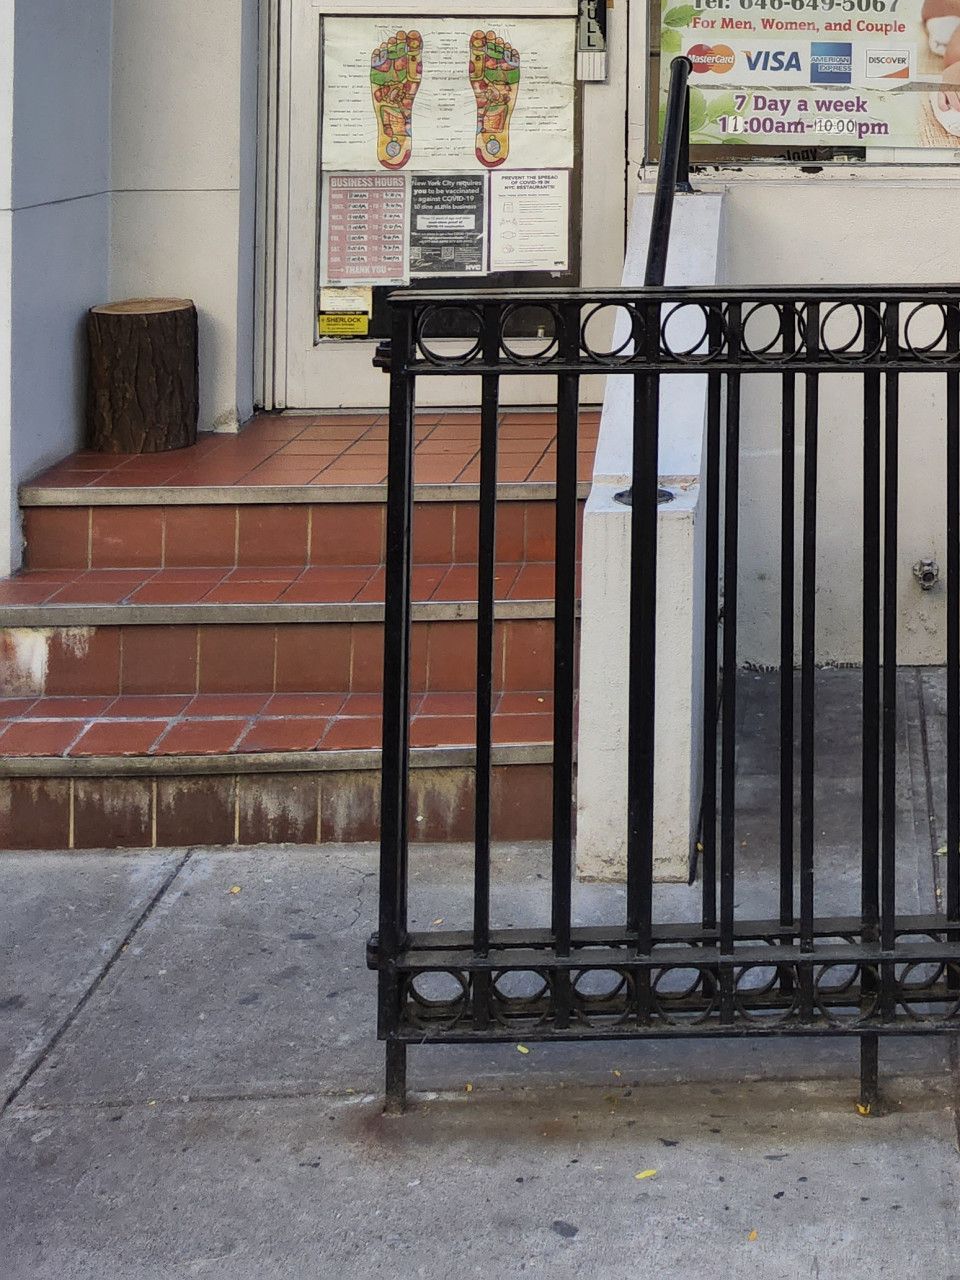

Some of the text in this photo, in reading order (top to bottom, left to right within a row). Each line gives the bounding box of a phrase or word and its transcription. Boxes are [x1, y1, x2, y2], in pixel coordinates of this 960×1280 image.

[692, 17, 906, 35] For Men, Women, and Couple
[741, 50, 801, 71] VISA
[811, 56, 849, 64] AMERICAN
[869, 56, 907, 64] DISCOVER
[735, 95, 868, 116] 7 Day a week
[331, 177, 403, 187] BUSINESS HOURS
